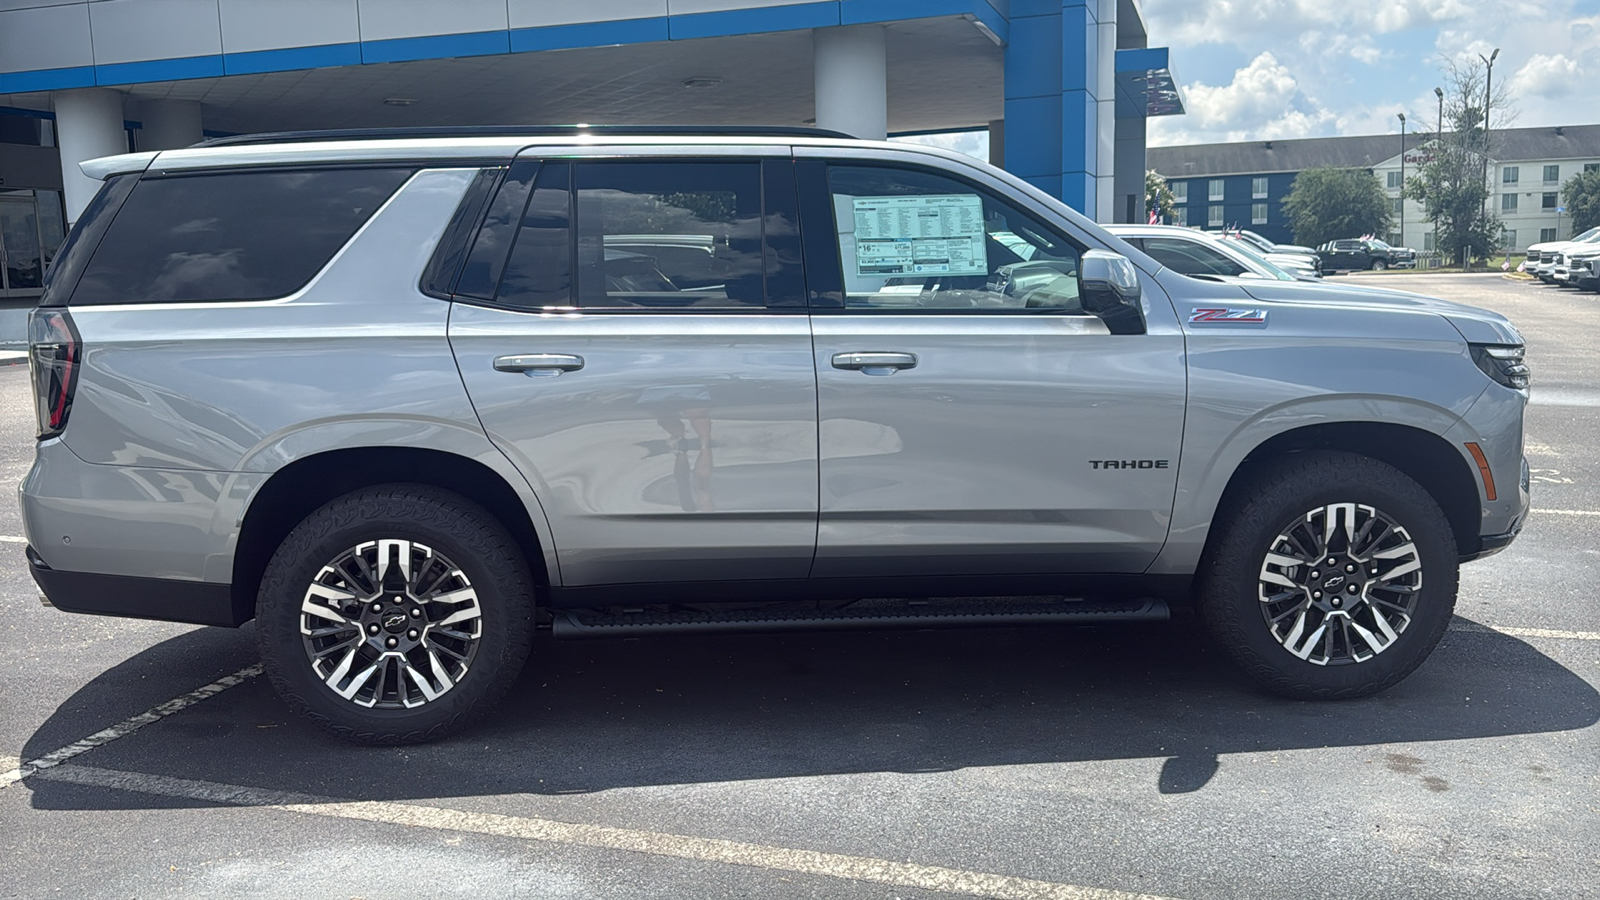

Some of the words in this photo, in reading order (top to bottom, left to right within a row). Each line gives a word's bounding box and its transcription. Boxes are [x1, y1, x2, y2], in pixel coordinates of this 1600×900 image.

[1404, 154, 1437, 163] Garde
[862, 244, 872, 252] 16
[1188, 307, 1268, 322] Z71
[1088, 460, 1169, 469] TAHOE
